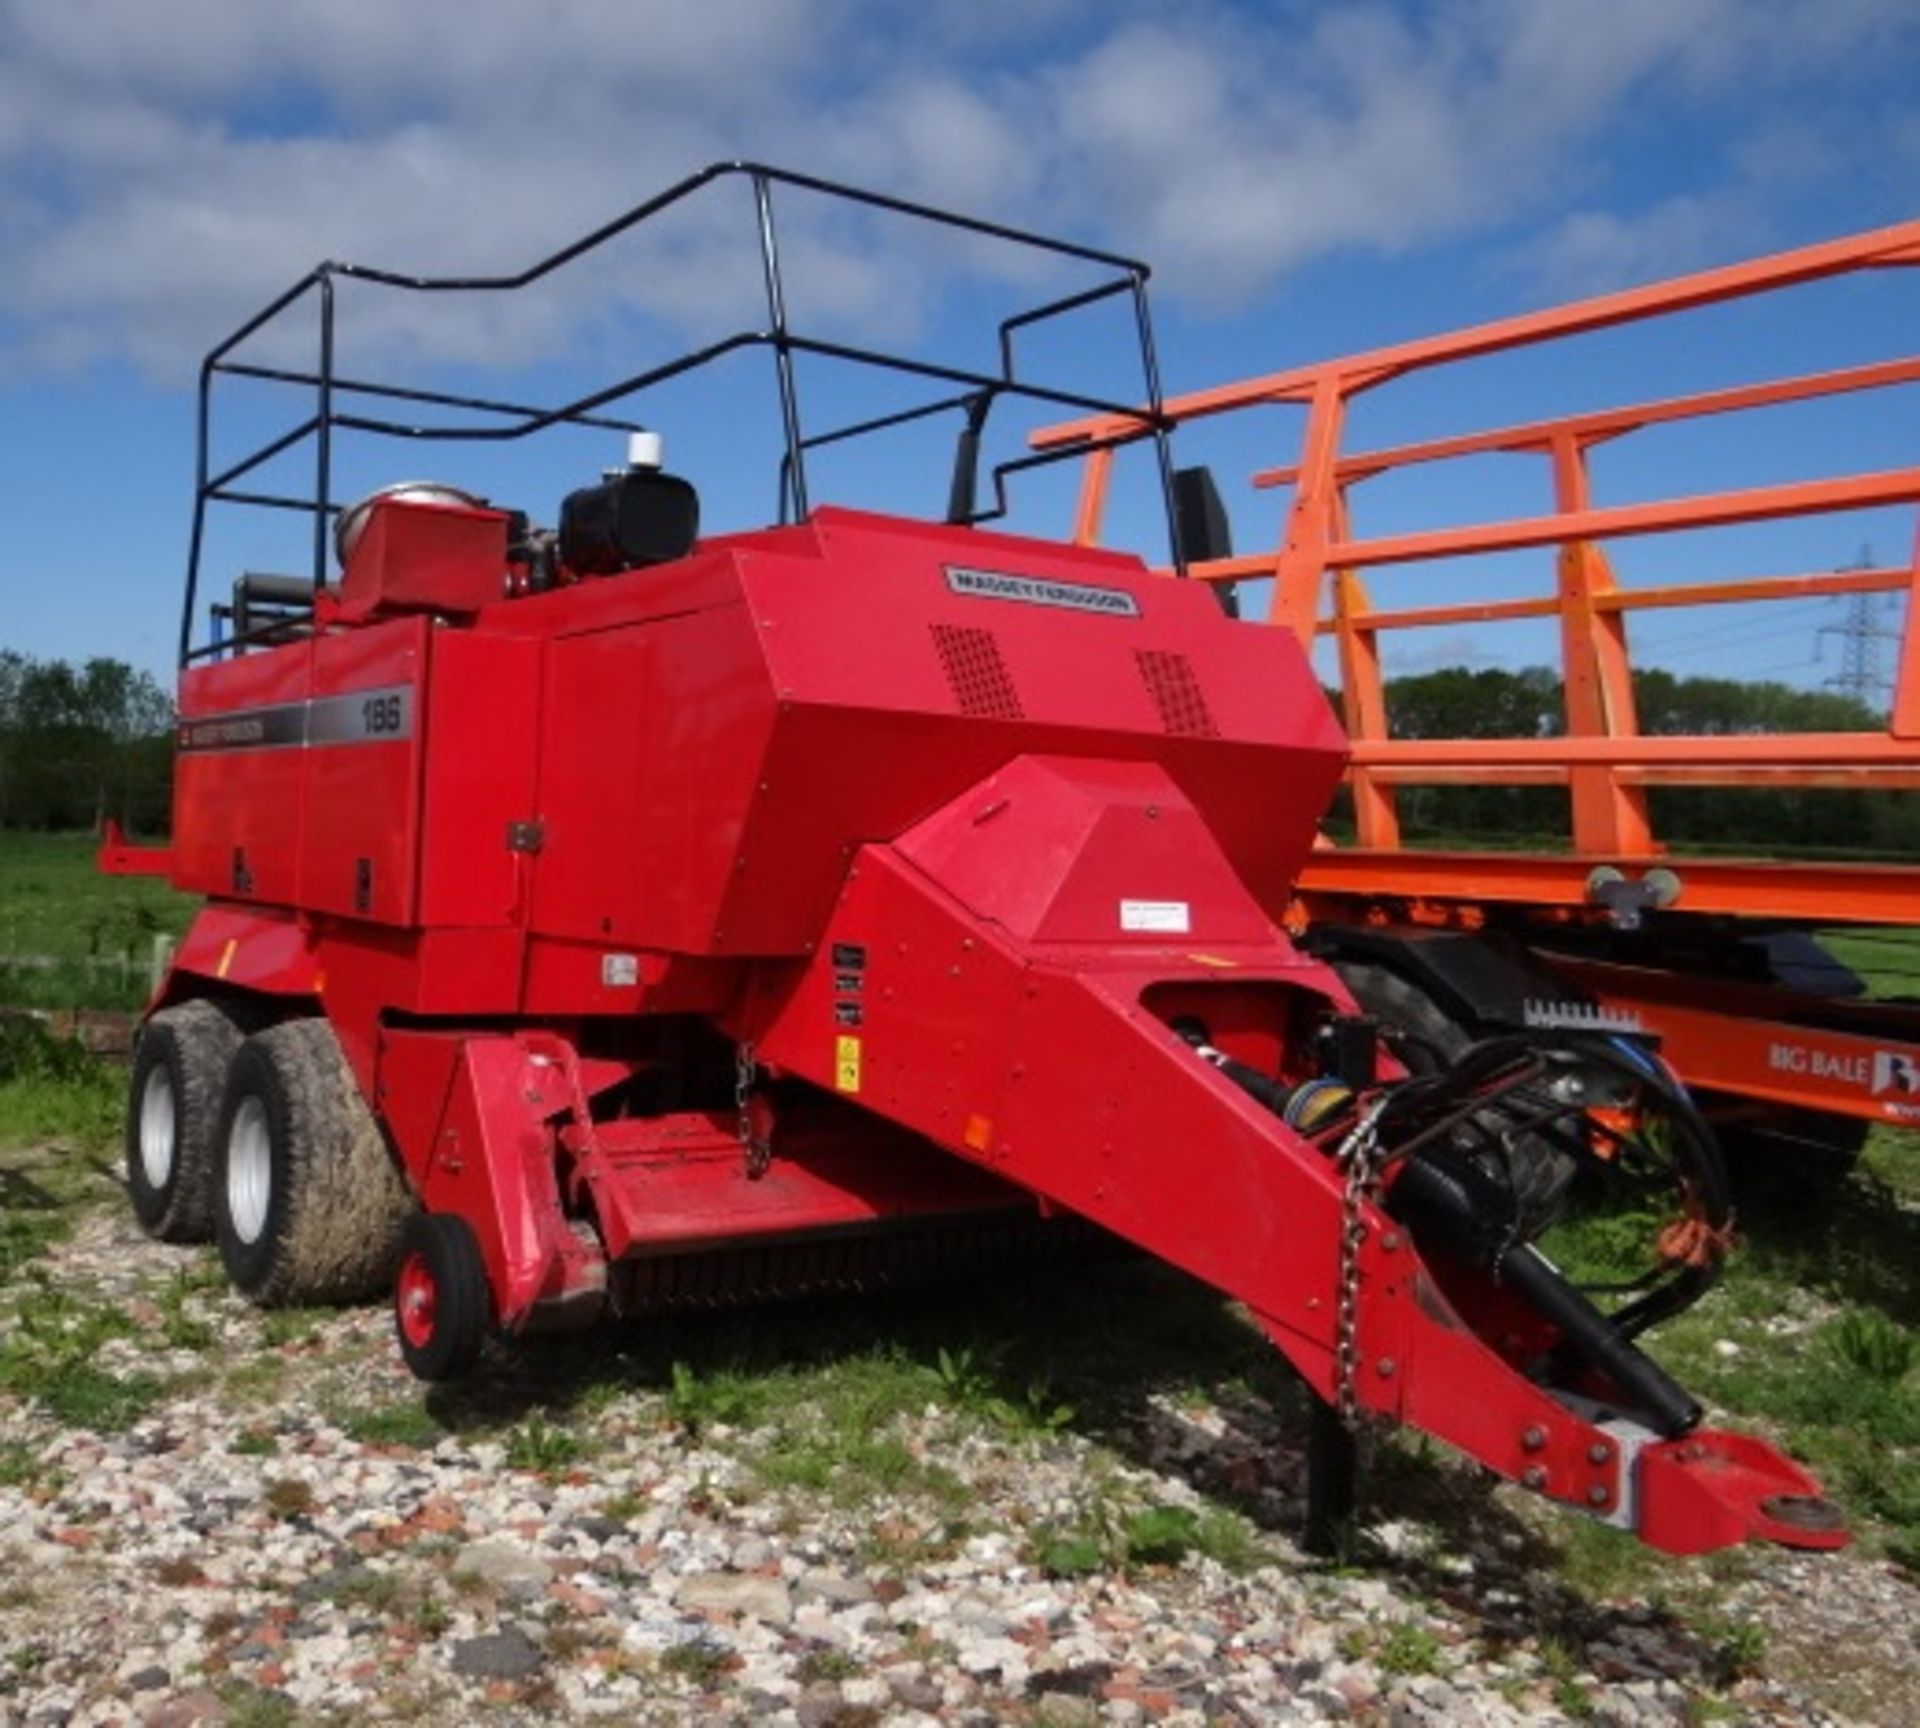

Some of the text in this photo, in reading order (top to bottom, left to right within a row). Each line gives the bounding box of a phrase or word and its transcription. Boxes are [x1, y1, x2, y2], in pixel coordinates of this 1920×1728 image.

[953, 572, 1131, 612] MASSEY FERGUSON
[1768, 1042, 1869, 1083] BIG BALE
